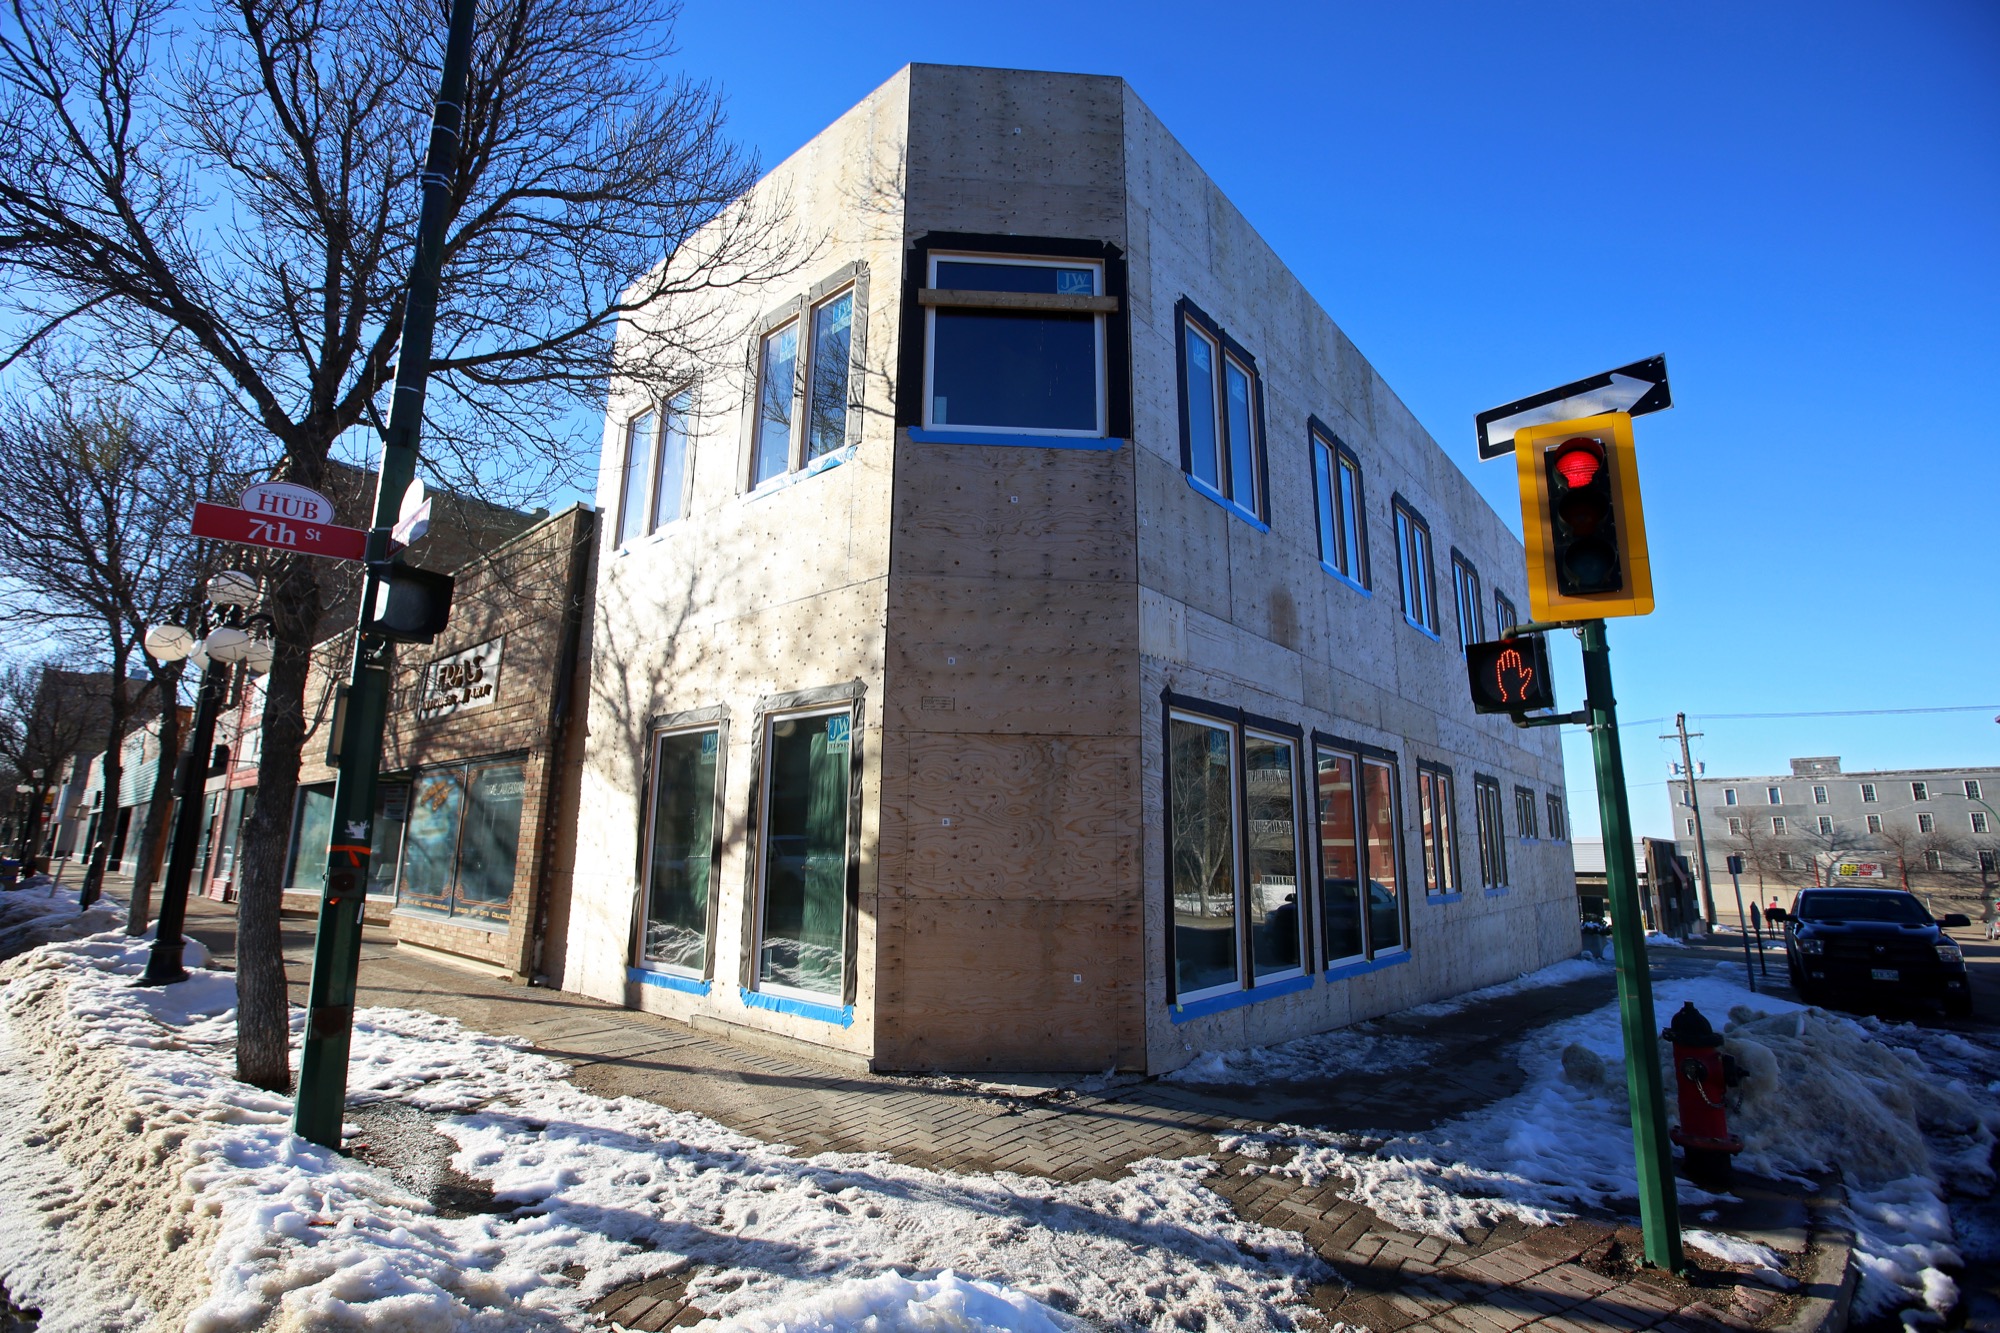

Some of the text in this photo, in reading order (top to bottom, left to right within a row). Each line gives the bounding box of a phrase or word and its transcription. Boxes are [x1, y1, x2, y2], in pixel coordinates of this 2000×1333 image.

[1061, 272, 1089, 289] JW
[256, 493, 318, 520] HUB
[275, 491, 320, 503] DOWNTOWN
[247, 518, 322, 546] 7th St
[830, 716, 850, 739] JW
